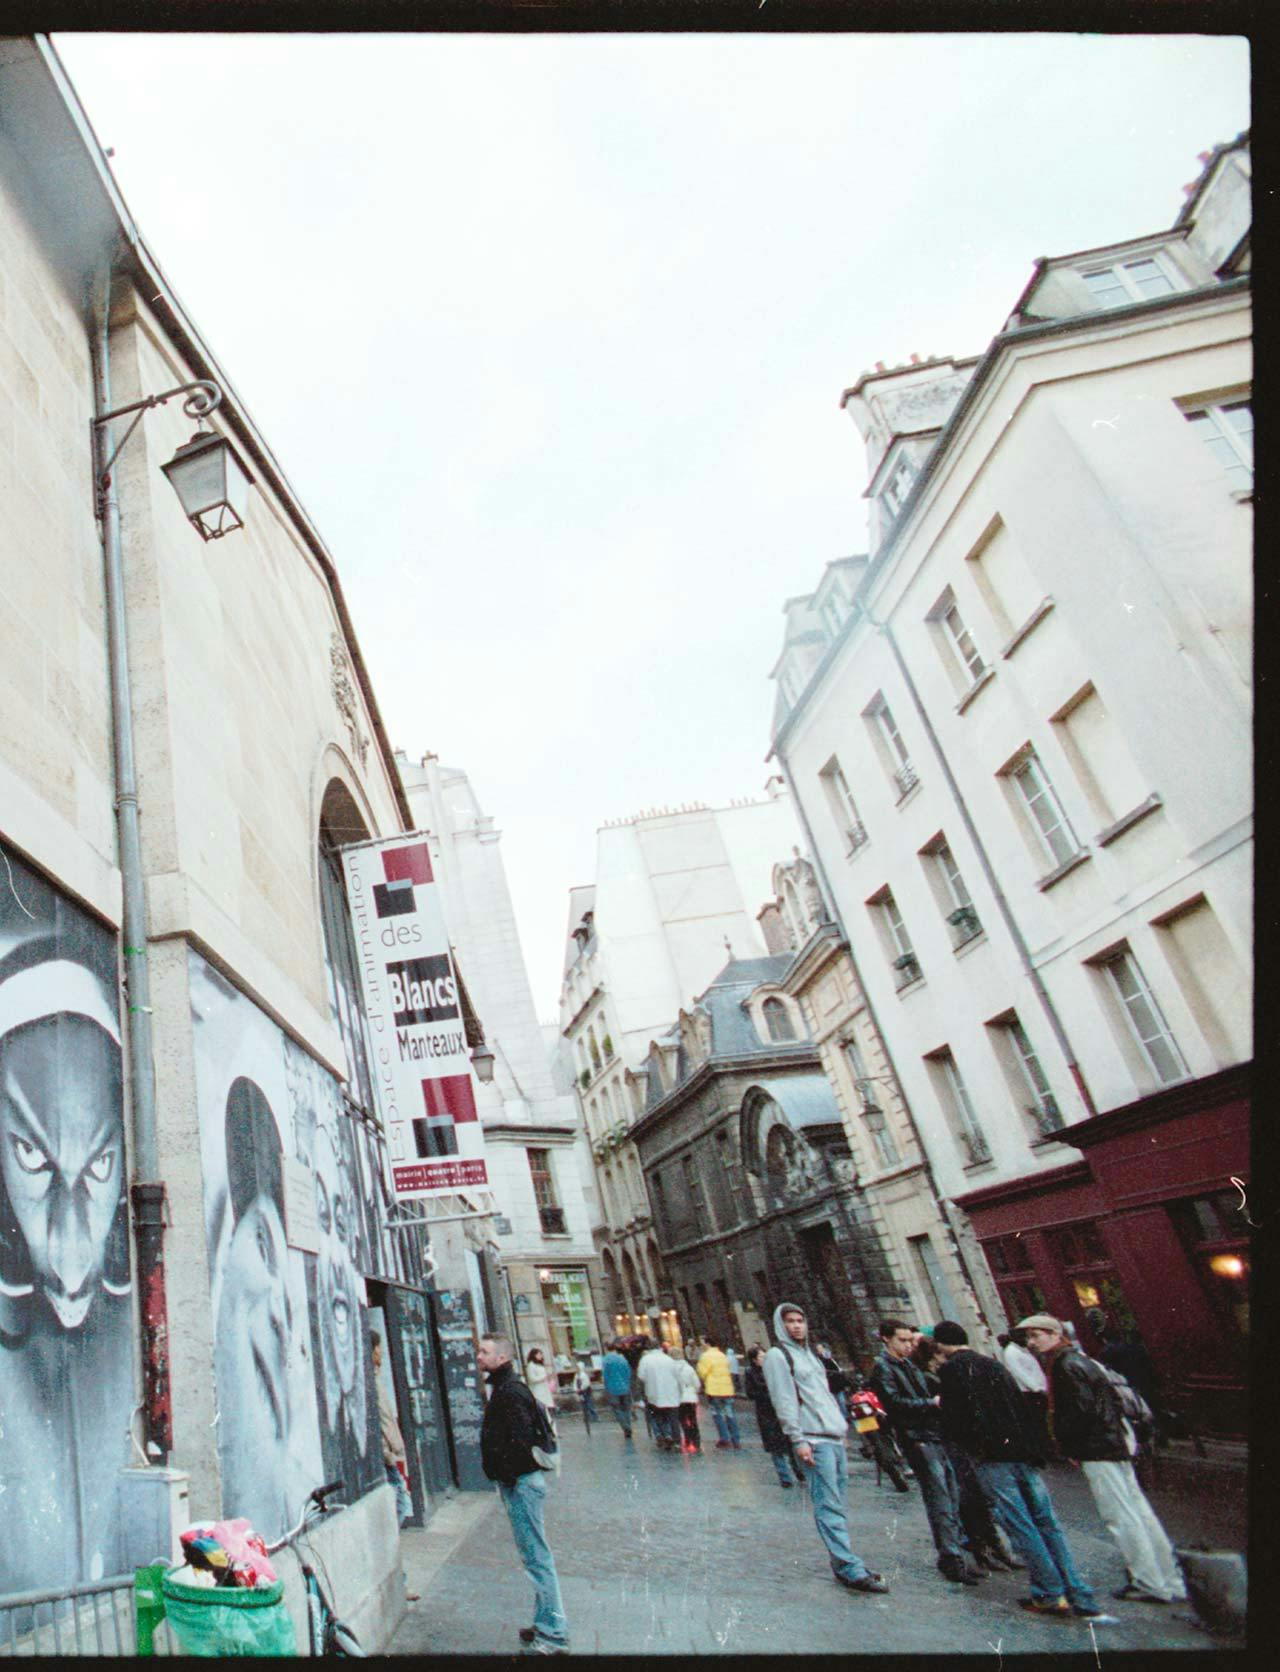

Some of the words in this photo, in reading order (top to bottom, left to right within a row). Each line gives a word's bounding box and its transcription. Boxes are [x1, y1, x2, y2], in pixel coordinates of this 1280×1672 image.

[348, 855, 384, 1033] d'animation
[380, 920, 422, 948] des
[389, 970, 457, 1013] Blancs
[396, 1028, 466, 1062] Manteaux
[378, 1047, 406, 1162] Espace
